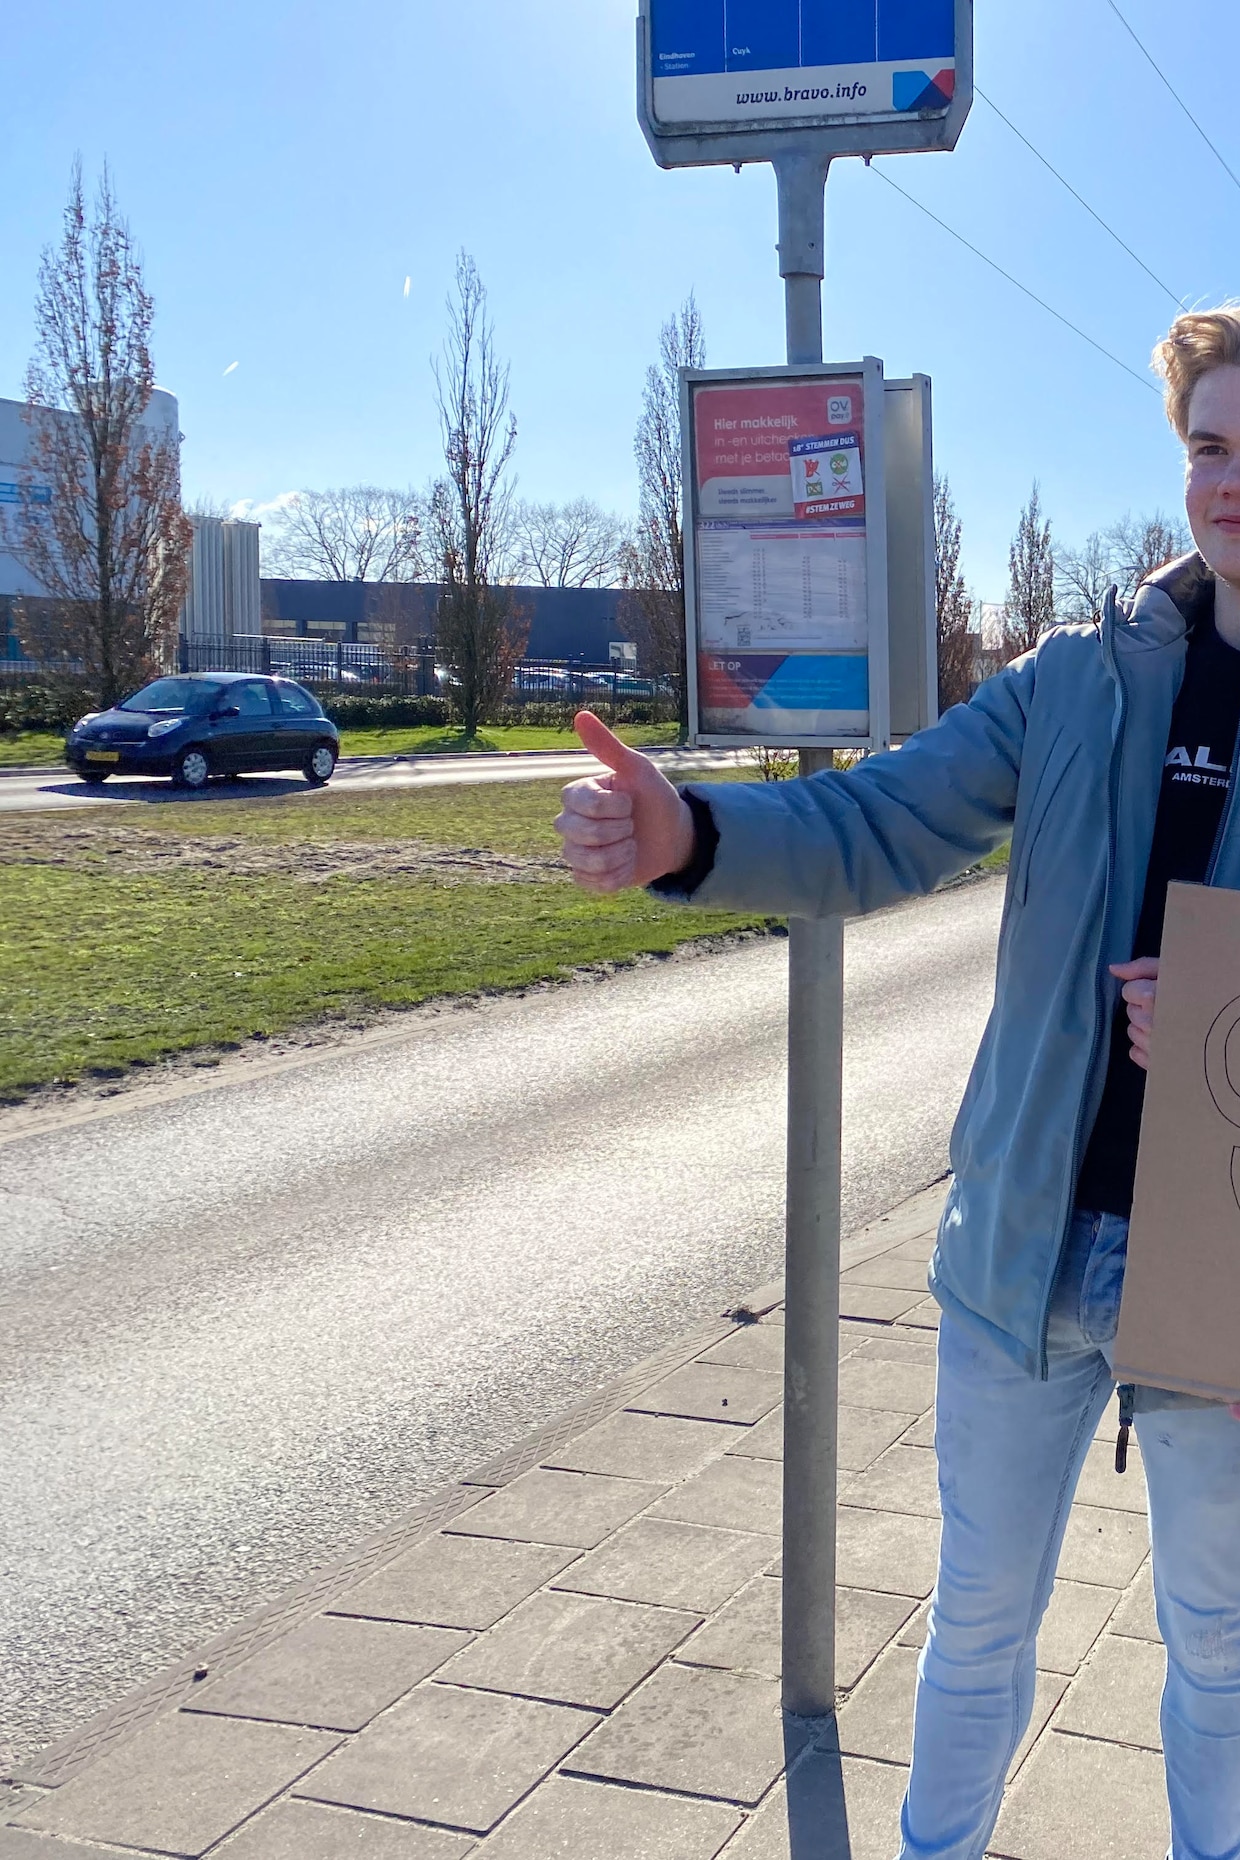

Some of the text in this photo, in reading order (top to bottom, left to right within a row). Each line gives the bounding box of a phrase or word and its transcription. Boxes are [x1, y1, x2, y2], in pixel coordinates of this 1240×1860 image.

[659, 52, 696, 60] Eindhoven
[732, 46, 751, 56] Cuyk
[735, 83, 867, 105] www.bravo.info
[830, 400, 849, 412] OV
[714, 415, 798, 430] Hier makkelijk
[714, 437, 725, 447] in
[805, 439, 839, 451] STEMMEN
[840, 436, 855, 446] DUS
[715, 452, 738, 464] met
[741, 453, 752, 466] je
[709, 661, 742, 671] LET OP
